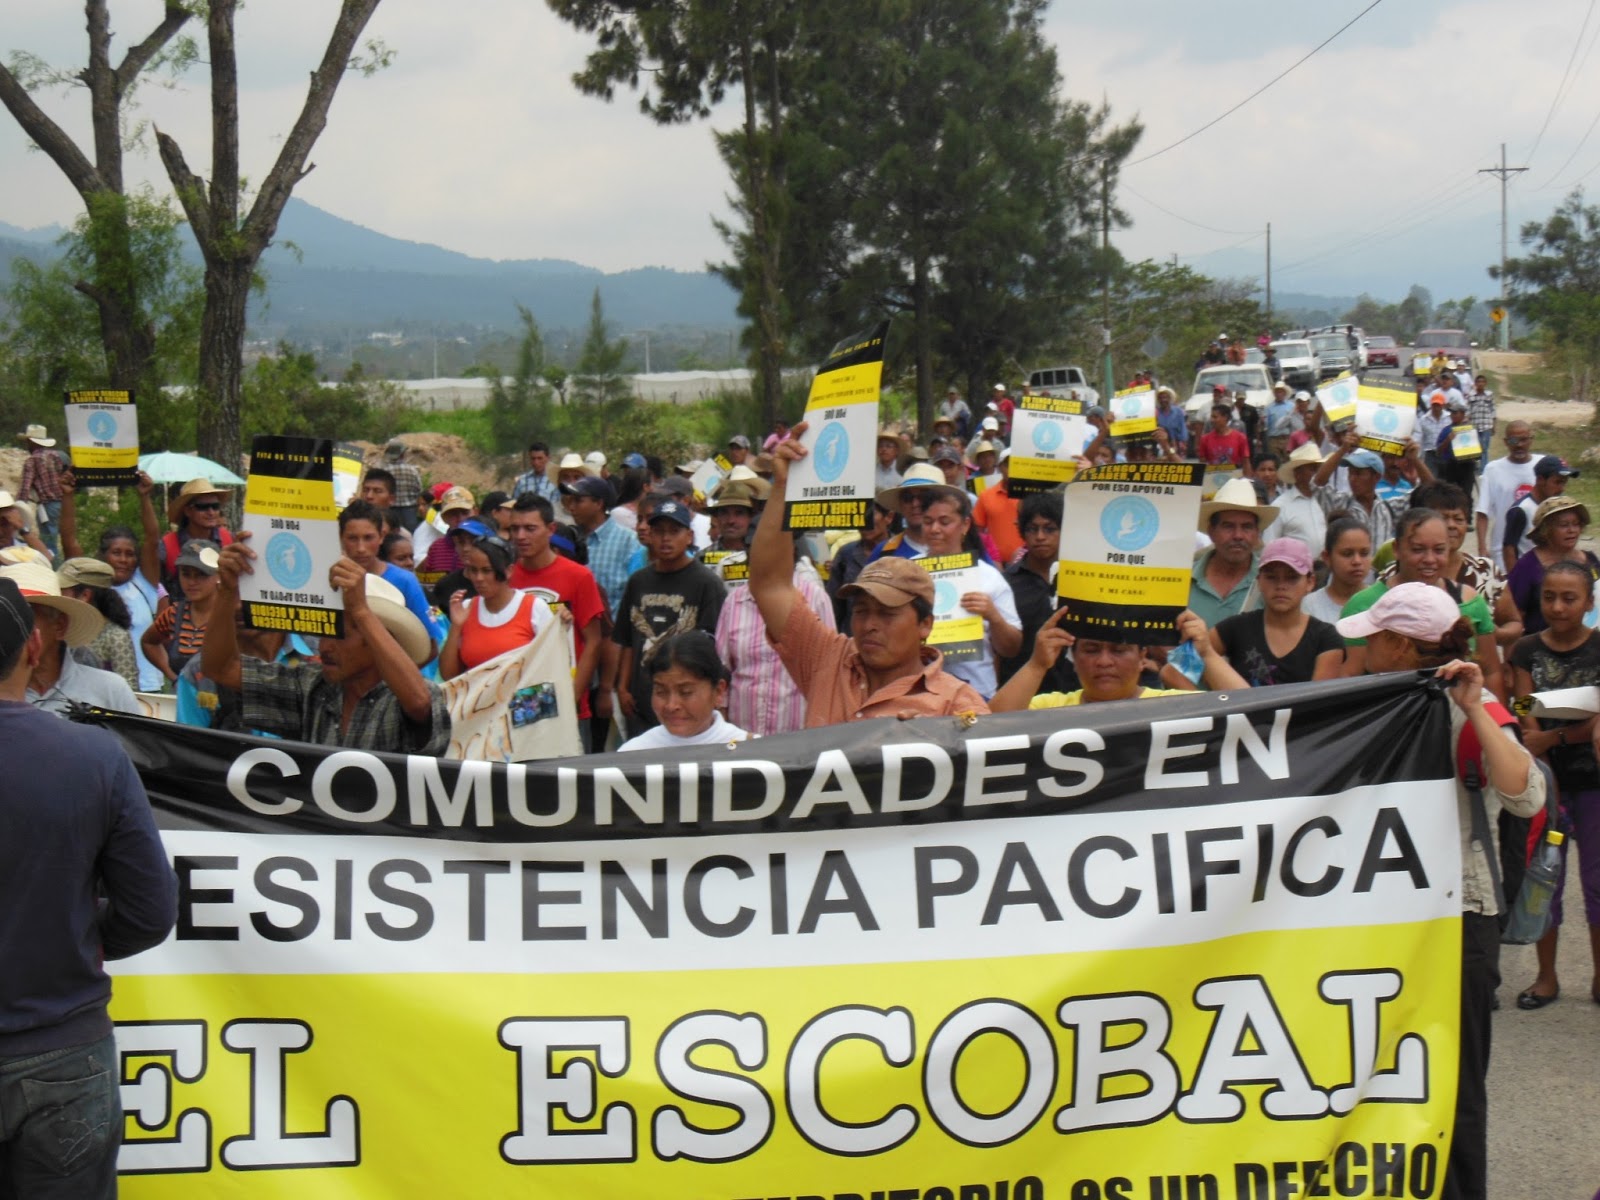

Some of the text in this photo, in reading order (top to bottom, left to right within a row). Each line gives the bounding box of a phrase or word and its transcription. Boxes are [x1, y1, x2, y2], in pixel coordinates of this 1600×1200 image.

[835, 408, 847, 419] POR
[1101, 464, 1137, 473] TENGO
[1140, 464, 1193, 474] DERECHO
[1133, 473, 1141, 481] A
[1144, 474, 1191, 483] DECIDIR
[830, 486, 840, 496] ESO
[843, 485, 855, 495] POR
[1092, 483, 1175, 495] POR ESO APOYO AL
[822, 503, 828, 514] A
[859, 501, 866, 514] A
[271, 518, 300, 531] POR QUE
[825, 514, 851, 527] TENGO
[853, 514, 865, 526] YO
[1107, 552, 1145, 565] POR QUE
[1098, 573, 1131, 581] RAFAEL
[260, 590, 324, 604] POR ESO APOYO AL
[250, 604, 287, 619] DECIDIR
[288, 607, 295, 619] A
[329, 611, 336, 623] A
[252, 615, 336, 635] YO TENGO DERECHO
[1066, 613, 1080, 621] LA
[1087, 617, 1116, 627] MINA
[1144, 621, 1174, 629] PASA
[226, 728, 1105, 827] COMUNIDADES
[1143, 708, 1293, 790] EN
[173, 807, 1430, 942] ESISTENCIA PACIFICA
[114, 967, 1430, 1175] EL ESCOBAL
